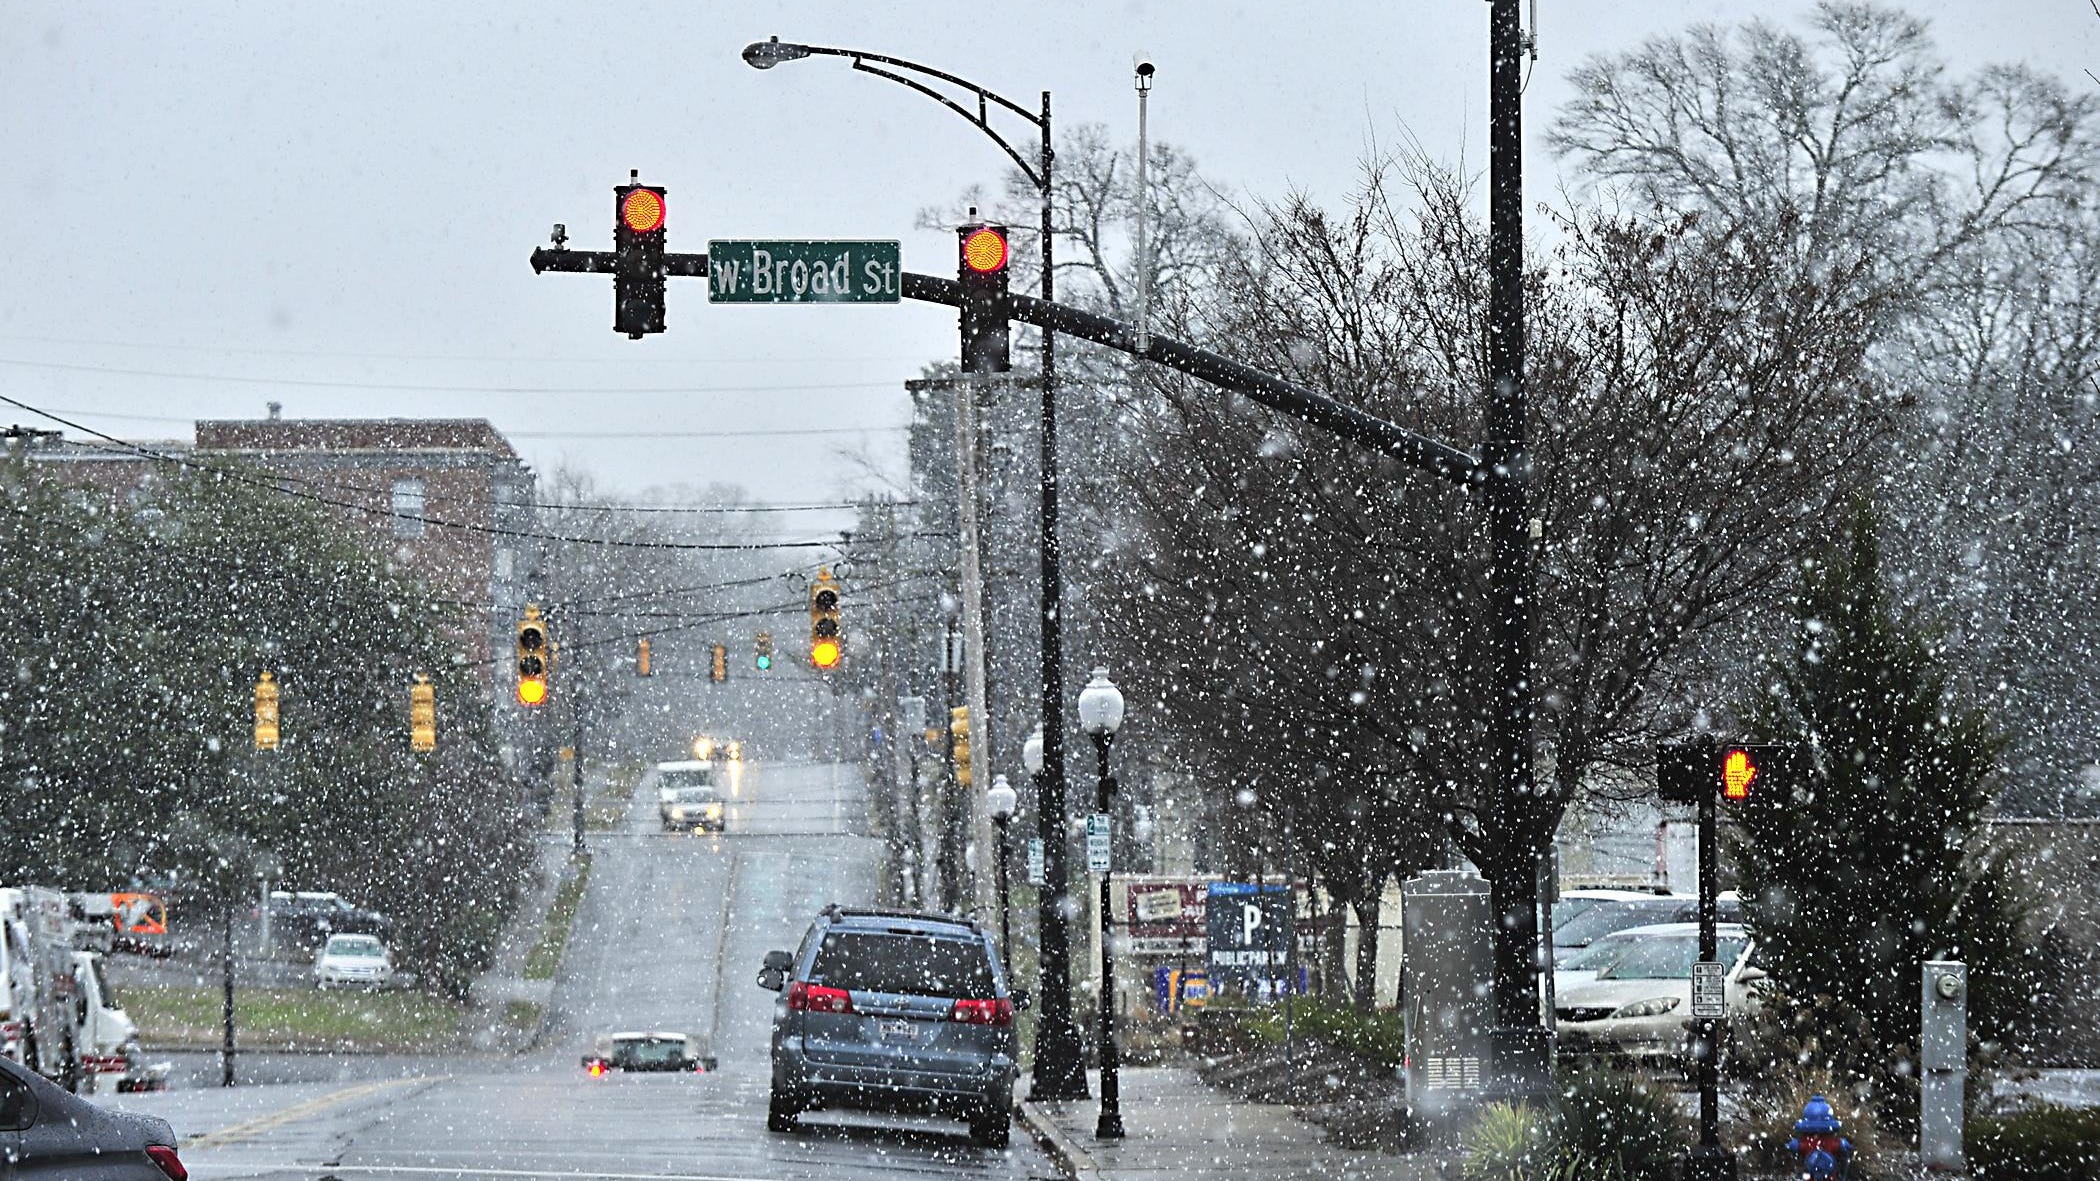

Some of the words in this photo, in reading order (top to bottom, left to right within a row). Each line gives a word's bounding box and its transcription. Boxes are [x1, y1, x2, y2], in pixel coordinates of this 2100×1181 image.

[753, 249, 850, 295] Broad
[863, 259, 896, 295] St
[1244, 904, 1261, 945] P
[1212, 951, 1248, 966] PUBLIC
